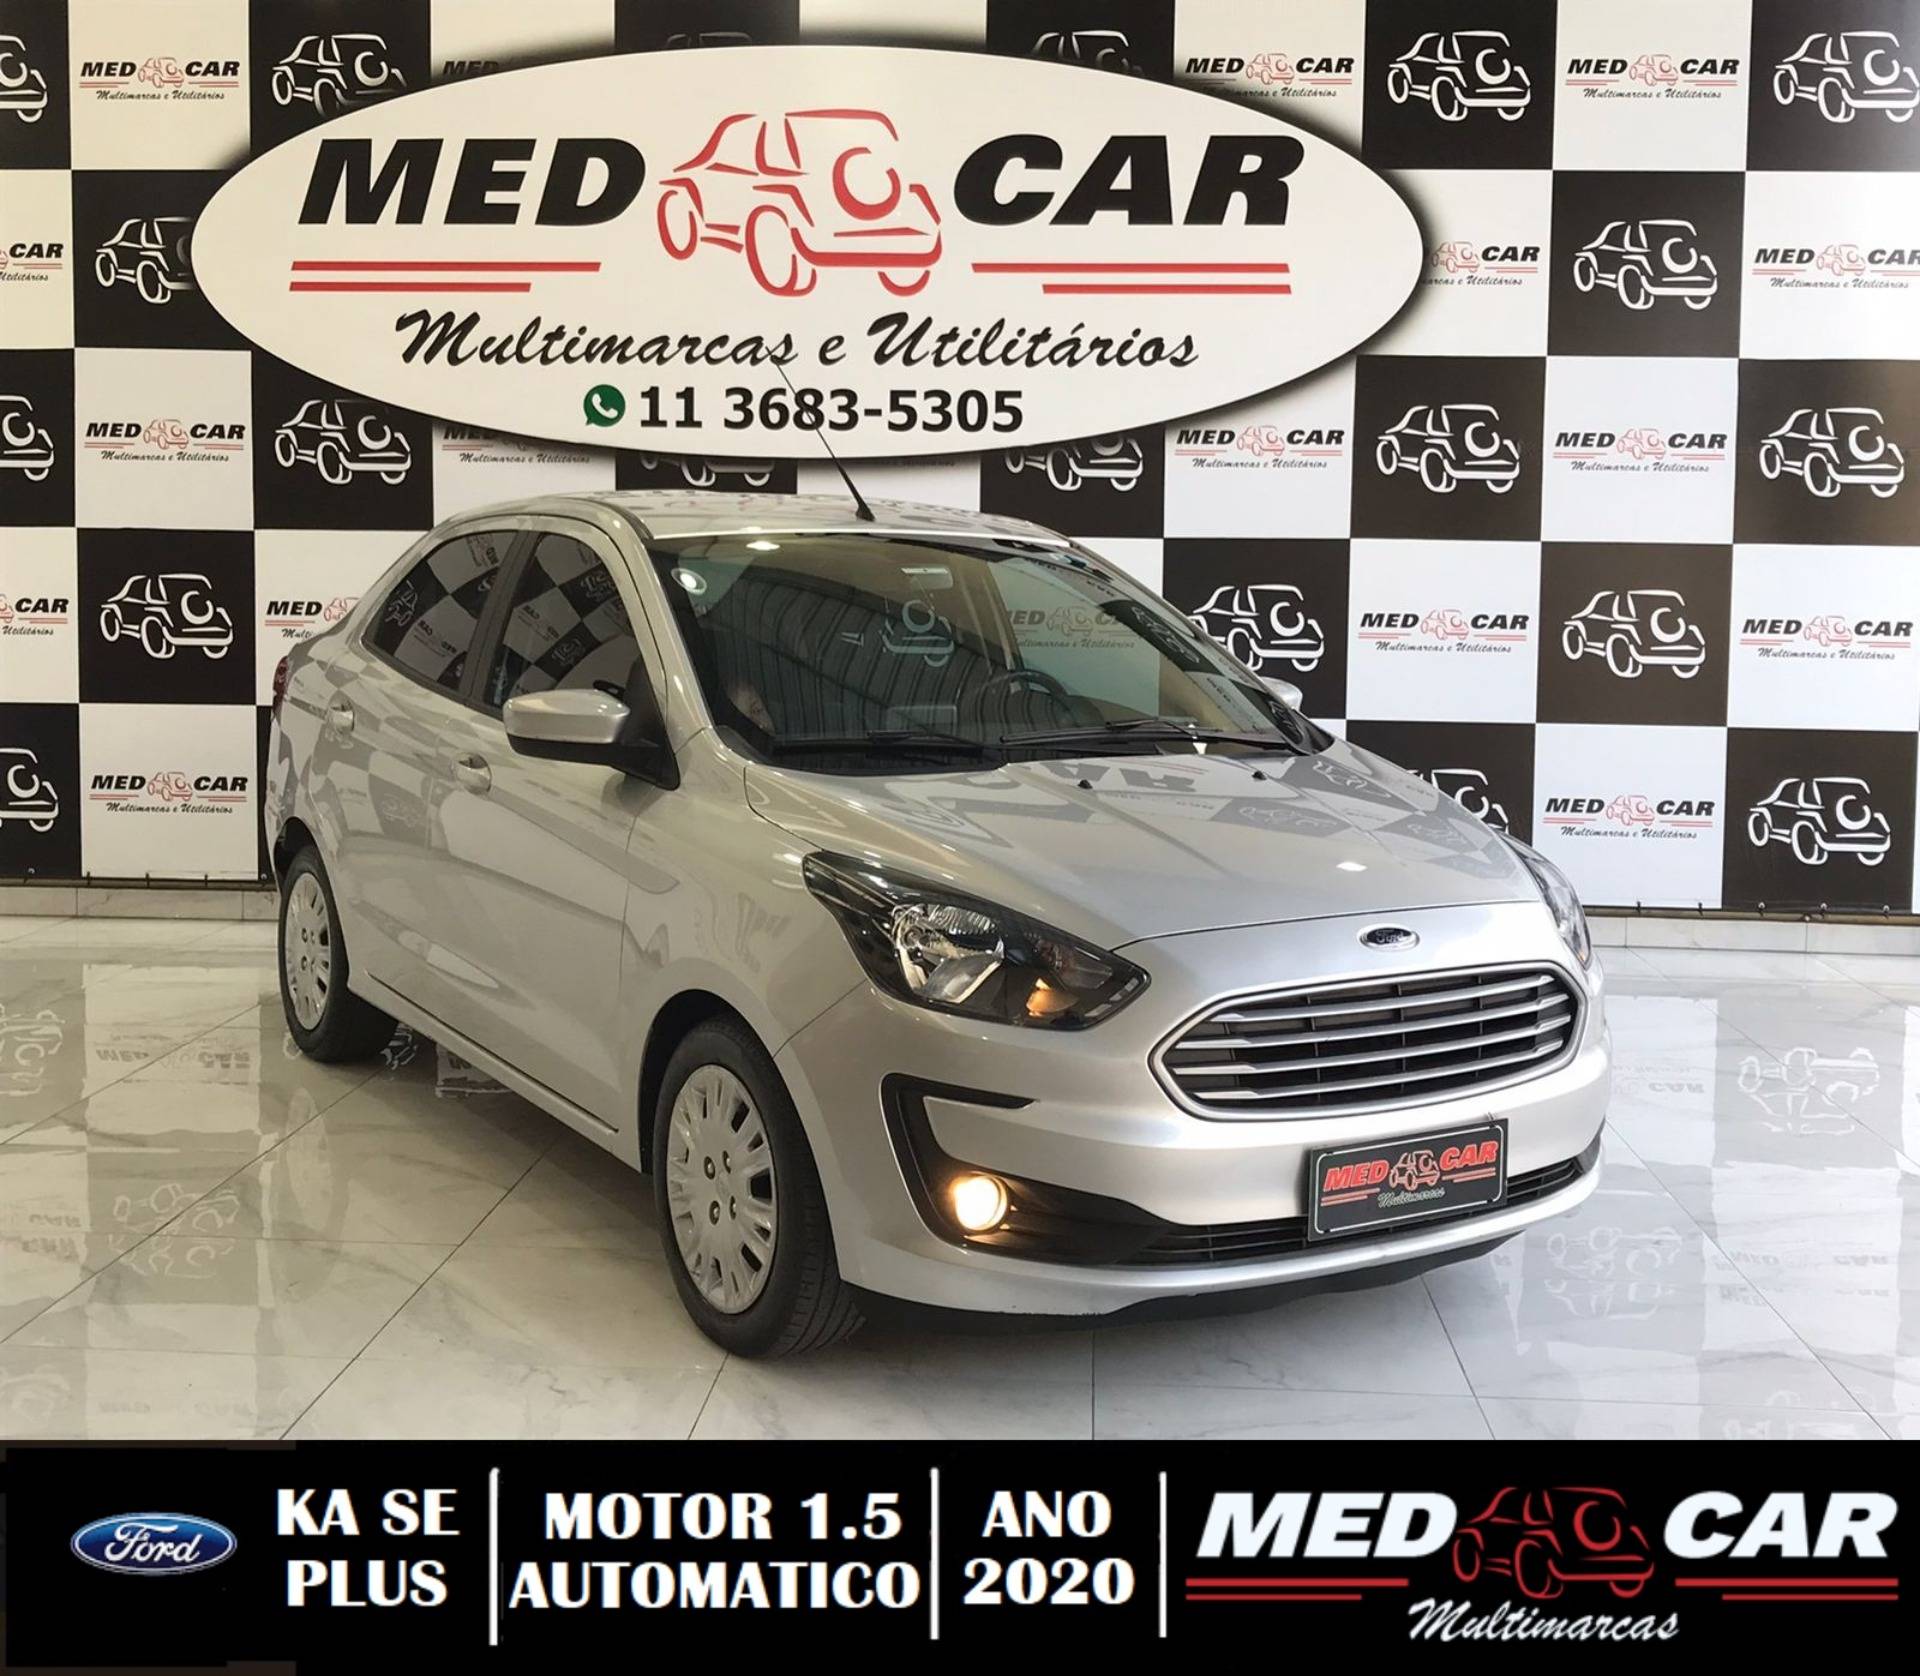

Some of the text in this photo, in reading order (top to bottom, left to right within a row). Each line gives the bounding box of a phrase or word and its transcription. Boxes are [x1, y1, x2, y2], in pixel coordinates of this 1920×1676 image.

[81, 61, 240, 77] MED CAR
[1185, 58, 1354, 74] MED CAR
[1568, 59, 1739, 74] MED CAR
[298, 134, 1304, 226] MED CAR
[9, 243, 63, 258] CAR
[1482, 246, 1540, 261] CAR
[1755, 249, 1815, 264] MED
[395, 309, 1198, 368] Multimarcas e Utilitários
[641, 386, 1023, 433] 11 3683-5305
[86, 423, 245, 439] MED CAR
[1176, 430, 1344, 445] MED CAR
[1555, 432, 1727, 449] MED CAR
[15, 598, 69, 613] CAR
[267, 601, 322, 616] MED
[1361, 613, 1529, 630] MED CAR
[1743, 619, 1913, 636] MED CAR
[91, 775, 248, 792] MED CAR
[1545, 798, 1715, 816] MED CAR
[1323, 1140, 1499, 1191] MED CAR
